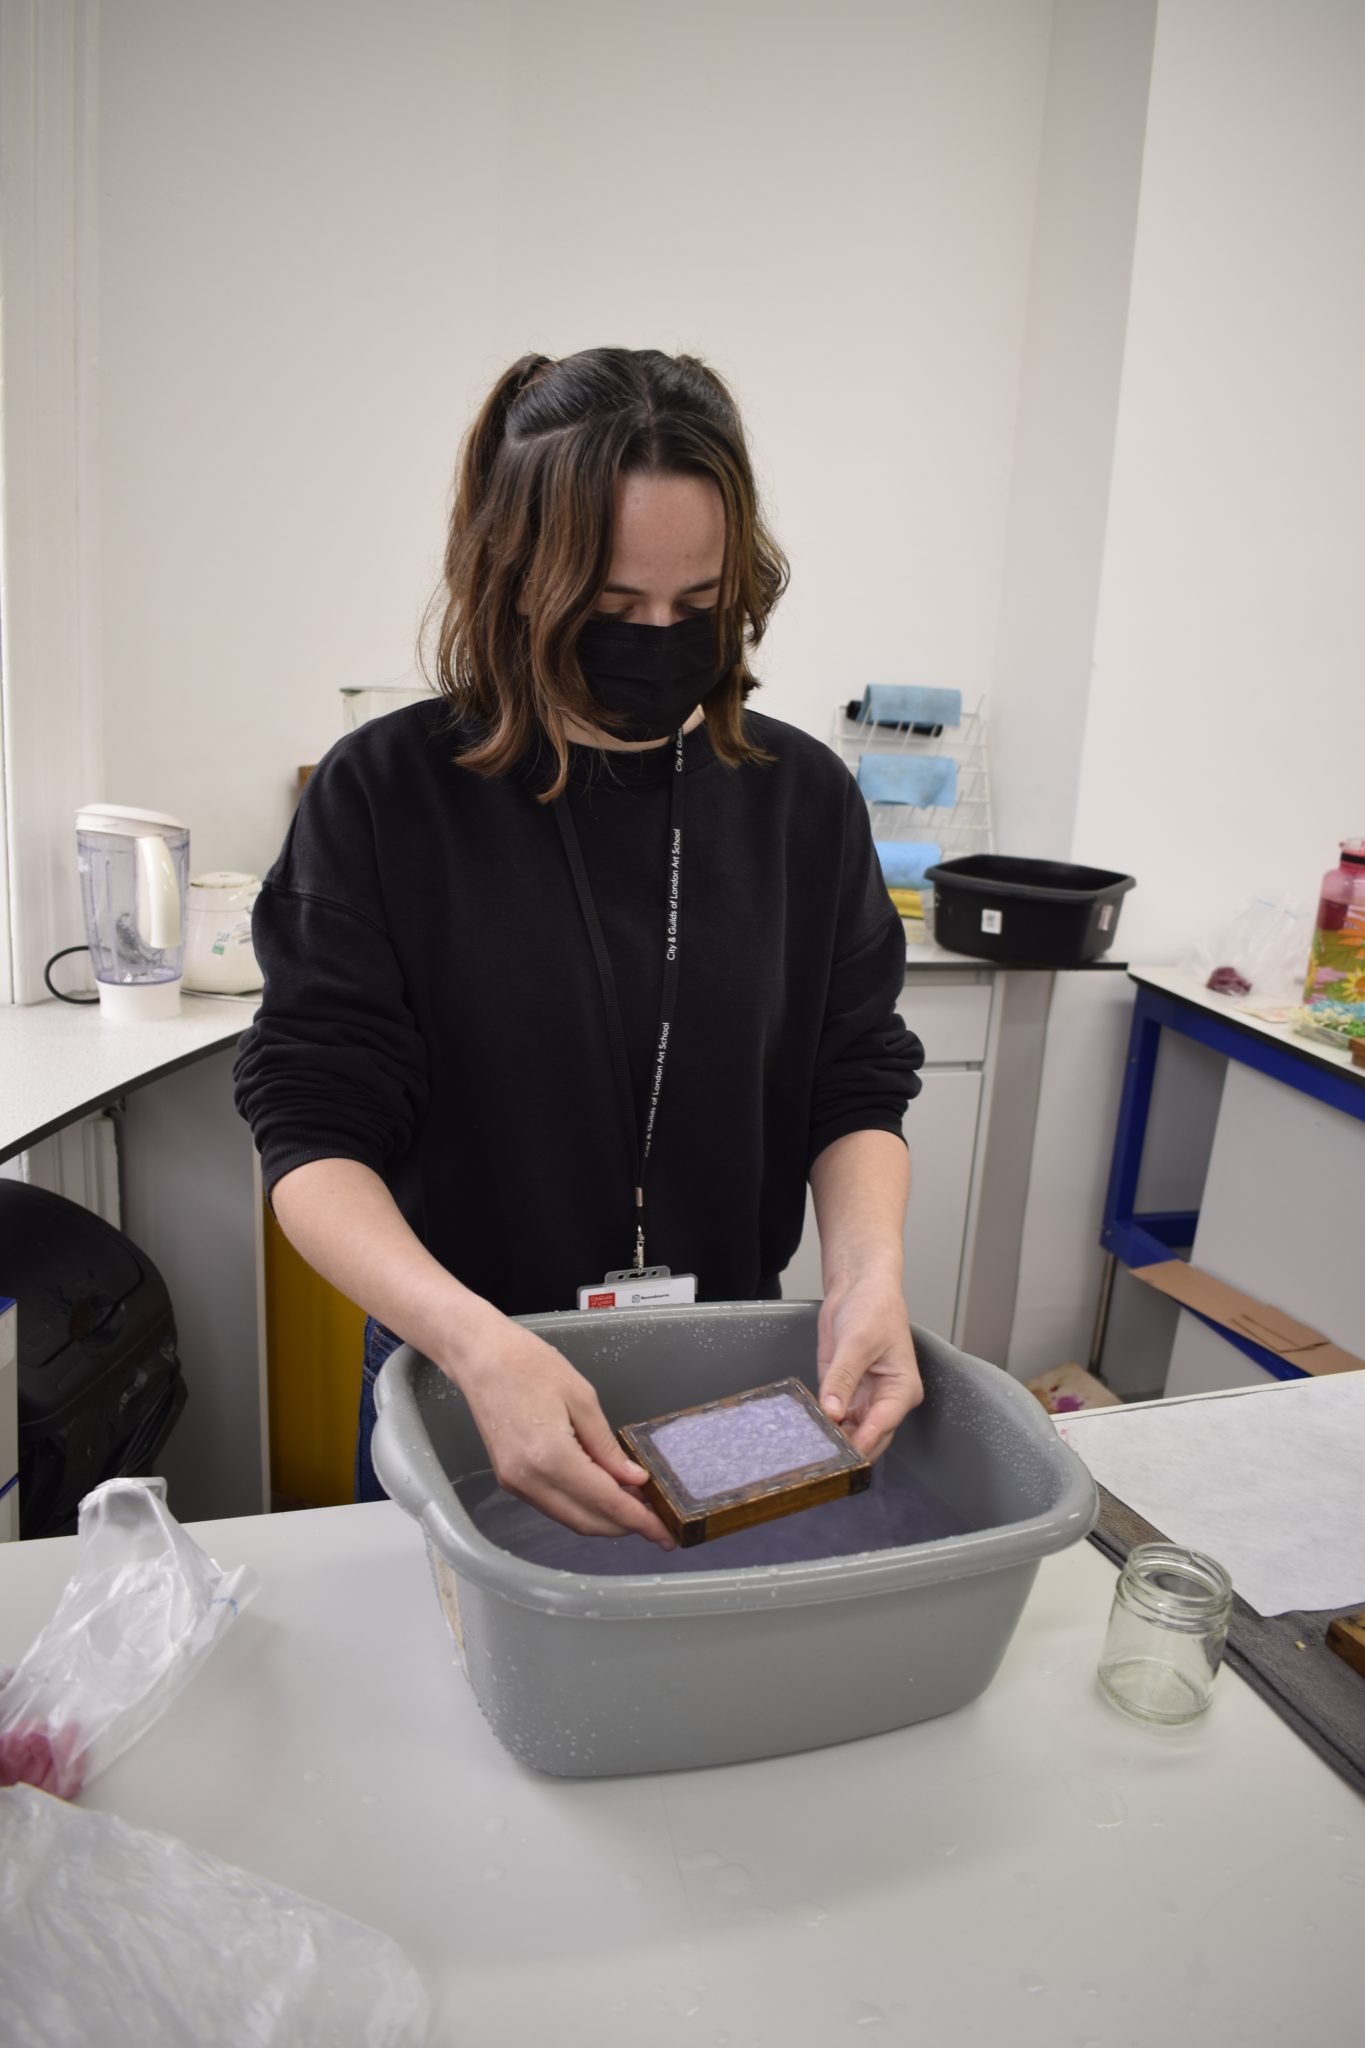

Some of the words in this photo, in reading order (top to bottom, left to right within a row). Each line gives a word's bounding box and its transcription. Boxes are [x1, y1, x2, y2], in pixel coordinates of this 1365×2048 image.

[675, 757, 684, 772] City
[672, 828, 681, 855] School
[671, 856, 680, 869] Art
[670, 870, 679, 899] London
[669, 900, 678, 909] of
[668, 910, 678, 935] Guilds
[666, 944, 677, 961] City
[658, 1022, 670, 1050] School
[656, 1051, 666, 1064] Art
[652, 1065, 663, 1095] London
[651, 1097, 658, 1105] of
[647, 1107, 657, 1131] Guilds
